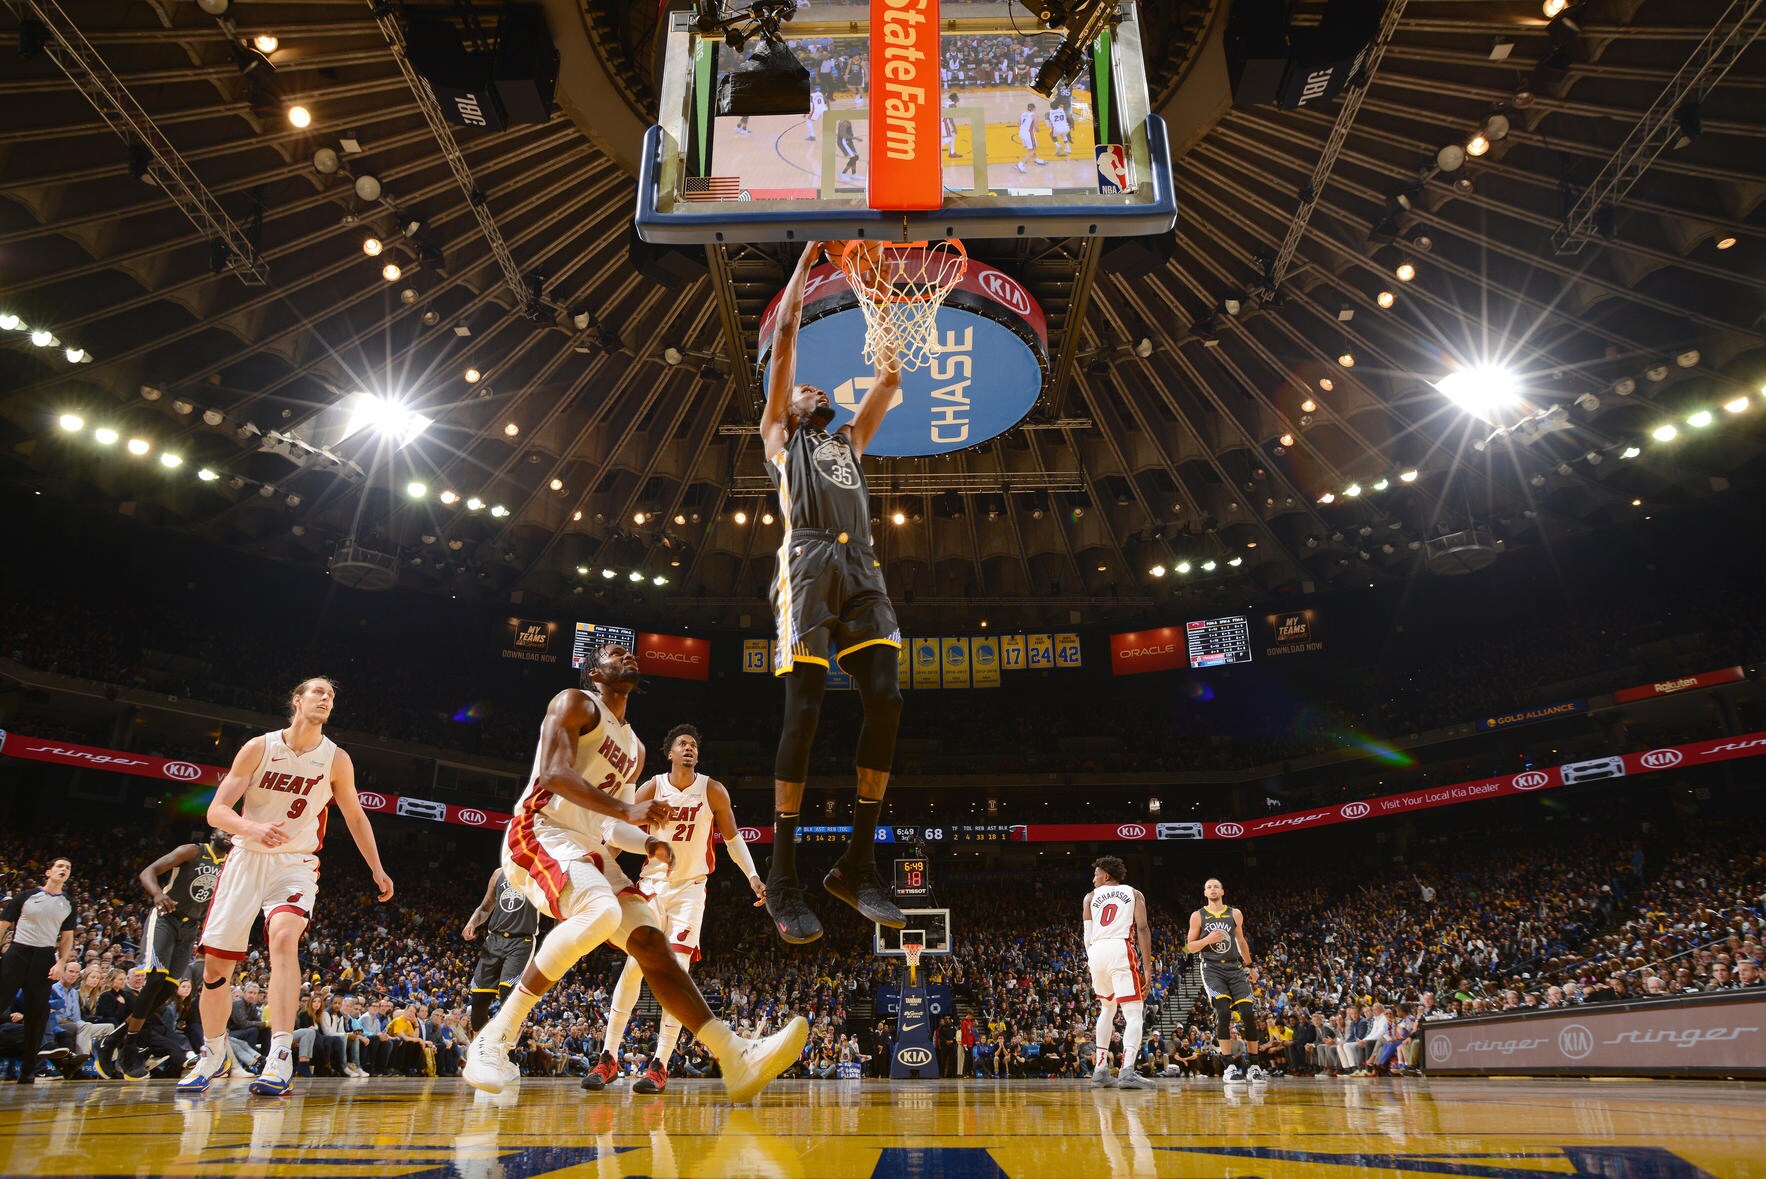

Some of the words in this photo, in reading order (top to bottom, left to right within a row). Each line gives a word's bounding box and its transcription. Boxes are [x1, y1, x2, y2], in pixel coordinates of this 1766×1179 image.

[1298, 67, 1334, 106] JBL
[454, 93, 487, 126] JBL
[1102, 185, 1118, 194] NBA
[989, 272, 1024, 309] KIA
[931, 326, 974, 444] CHASE
[831, 464, 852, 485] 35
[1286, 616, 1299, 626] MY
[527, 625, 541, 634] MY
[1279, 624, 1306, 635] TEAMS
[519, 632, 546, 643] TEAMS
[502, 649, 539, 661] DOWNLOAD
[541, 654, 557, 663] NOW
[1030, 647, 1052, 664] 24
[1058, 646, 1079, 663] 42
[1120, 644, 1176, 658] ORACLE
[1266, 644, 1304, 656] DOWNLOAD
[1306, 641, 1323, 651] NOW
[645, 650, 701, 664] ORACLE
[748, 652, 764, 668] 13
[1006, 648, 1021, 665] 17
[1654, 677, 1698, 692] Rakuten
[1497, 713, 1524, 725] GOLD
[1526, 703, 1576, 720] ALLIANCE
[26, 747, 149, 766] stinger
[597, 735, 637, 779] HEAT
[1647, 751, 1675, 766] KIA
[169, 764, 195, 778] KIA
[259, 771, 324, 797] HEAT
[1518, 774, 1543, 787] KIA
[359, 794, 381, 807] KIA
[1381, 799, 1400, 810] Visit
[1402, 796, 1423, 806] Your
[1426, 791, 1450, 803] Local
[1451, 787, 1467, 799] Kia
[1468, 782, 1500, 795] Dealer
[286, 798, 308, 820] 9
[662, 801, 703, 822] EAT
[1344, 803, 1366, 817] KIA
[462, 811, 482, 824] KIA
[1253, 812, 1331, 830] stinger
[672, 823, 696, 842] 21
[827, 834, 836, 842] 23
[896, 828, 914, 836] 6:49
[925, 828, 943, 841] 68
[194, 865, 222, 876] TOW
[904, 862, 924, 871] 6:49
[907, 871, 922, 887] 18
[195, 889, 210, 901] 23
[1092, 891, 1132, 909] RICHARDSON
[507, 900, 515, 910] 0
[1100, 903, 1119, 927] 0
[1203, 921, 1232, 933] TOWN
[1215, 942, 1226, 952] 30
[1562, 1031, 1589, 1052] KIA
[1602, 1026, 1759, 1048] stinger
[1433, 1039, 1448, 1056] KIA
[1458, 1038, 1549, 1054] stinger
[903, 1051, 926, 1062] KIA
